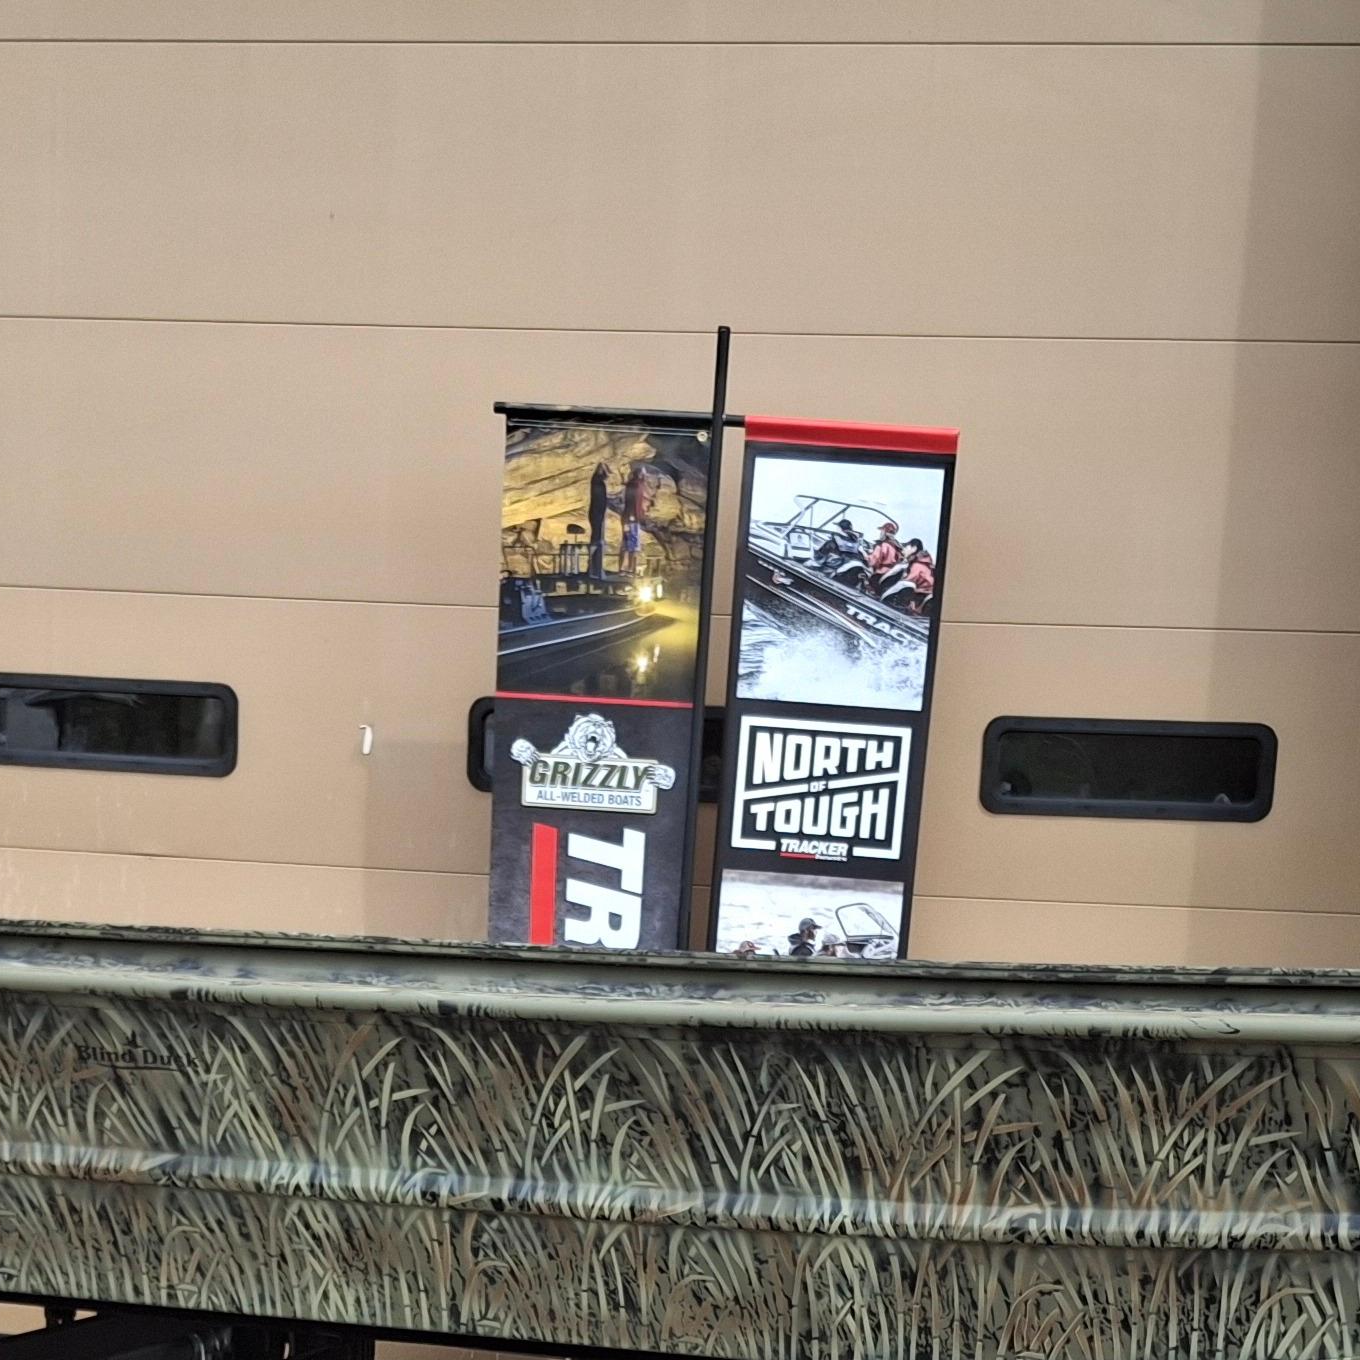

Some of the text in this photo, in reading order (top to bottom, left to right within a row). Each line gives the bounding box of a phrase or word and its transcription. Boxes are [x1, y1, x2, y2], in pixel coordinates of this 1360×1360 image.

[752, 731, 894, 785] NORTH
[529, 760, 650, 791] GRIZZLY
[809, 780, 828, 793] OF
[536, 789, 642, 807] ALL-WELDED BOATS
[750, 787, 890, 841] TOUGH
[779, 838, 848, 857] TRACKER
[77, 1045, 135, 1064] Blind
